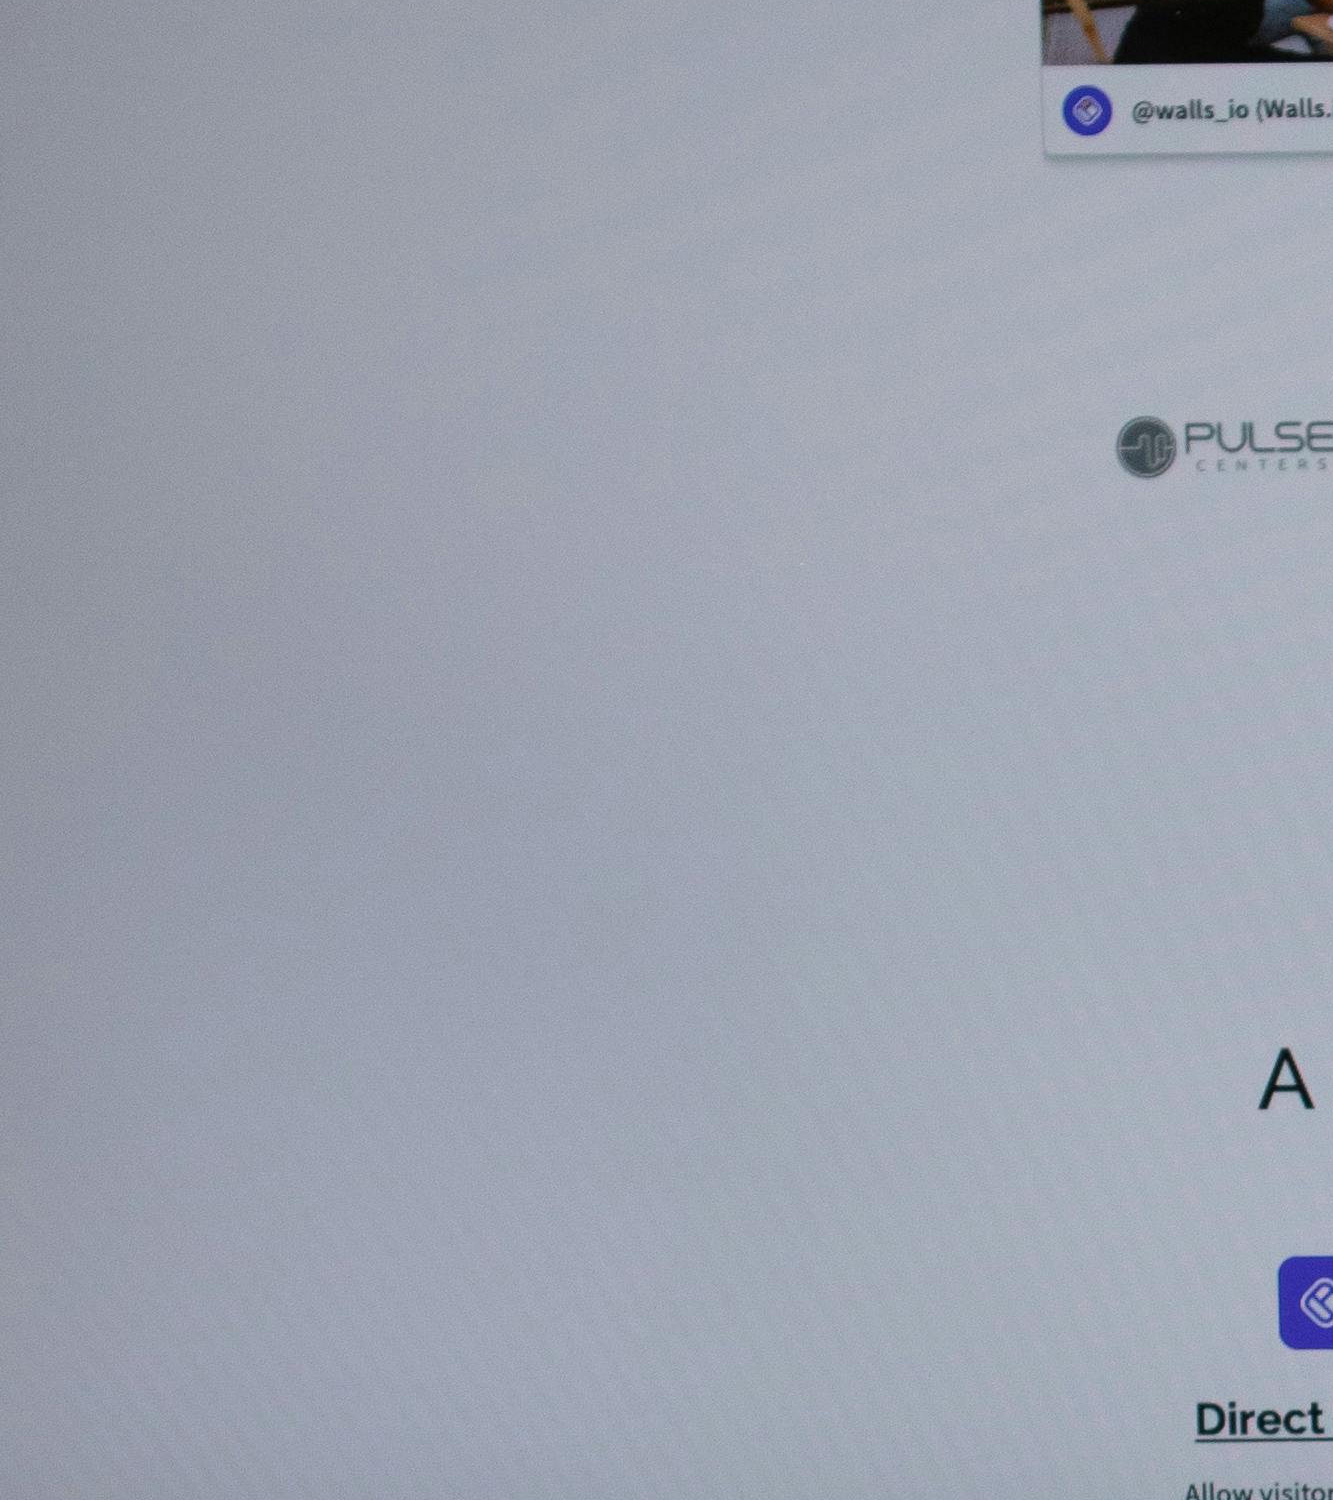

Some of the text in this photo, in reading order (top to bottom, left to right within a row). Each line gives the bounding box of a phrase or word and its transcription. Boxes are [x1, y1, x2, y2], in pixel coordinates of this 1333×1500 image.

[1131, 98, 1250, 125] @walls_io
[1195, 455, 1328, 473] CENTERS
[1258, 1046, 1315, 1110] A
[1196, 1400, 1325, 1436] Direct
